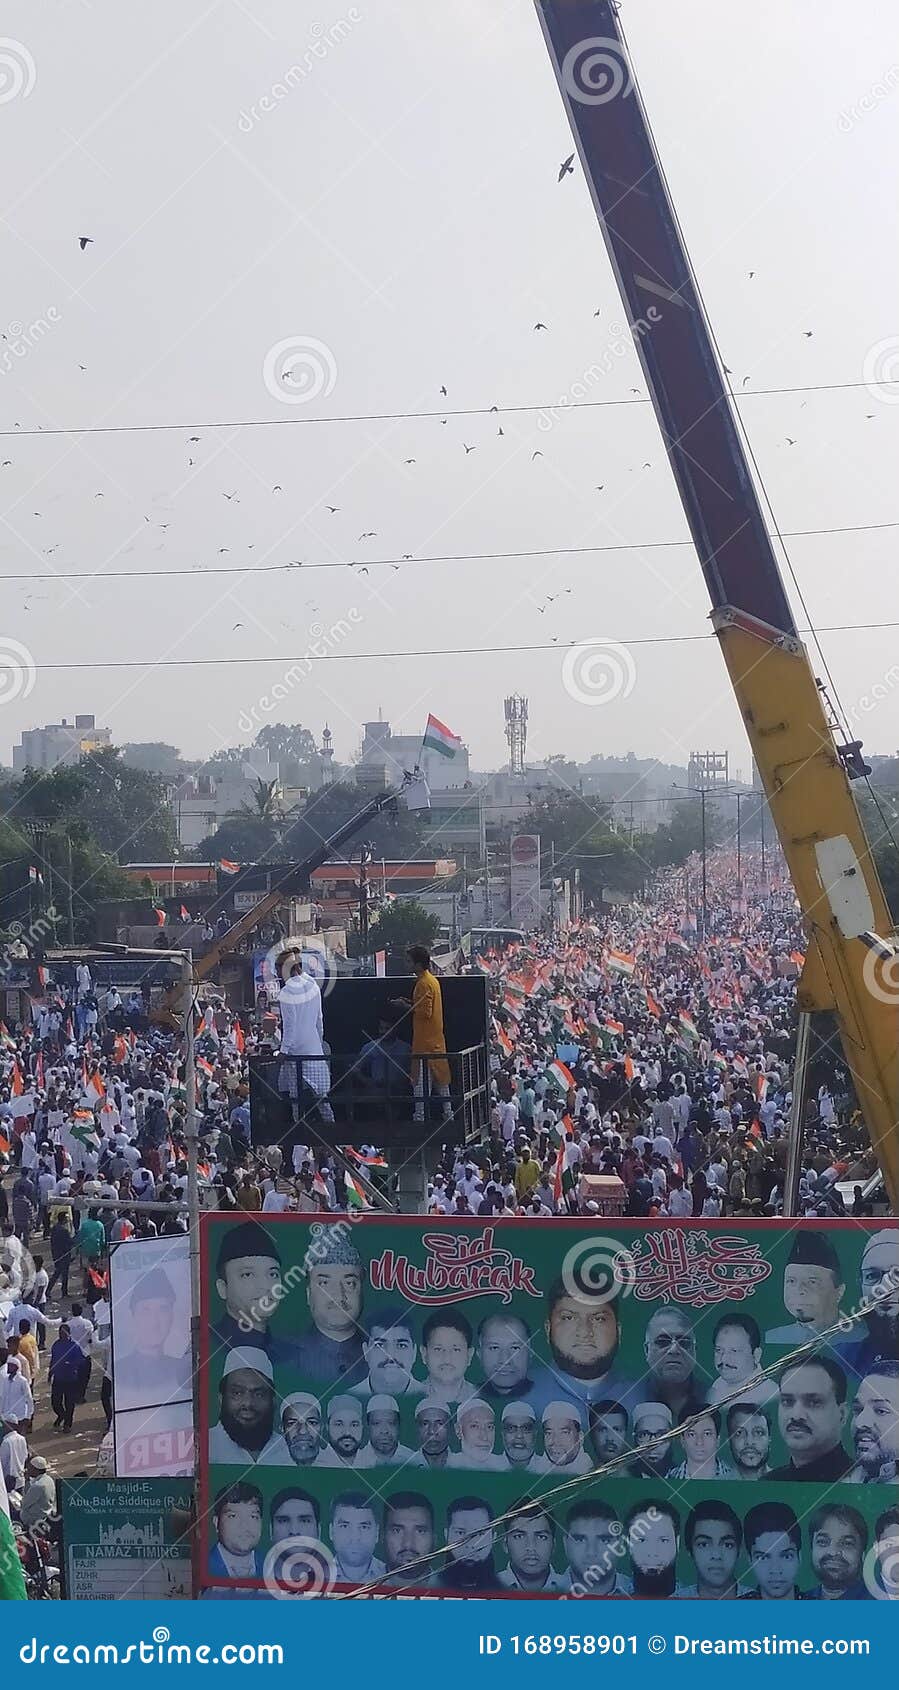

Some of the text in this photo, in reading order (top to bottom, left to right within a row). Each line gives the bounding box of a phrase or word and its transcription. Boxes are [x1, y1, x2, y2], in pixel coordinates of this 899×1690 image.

[422, 1227, 512, 1267] Eid
[370, 1250, 544, 1306] Mubarak
[69, 1496, 116, 1507] Abu-Bakr
[118, 1495, 161, 1508] Siddique
[86, 1546, 180, 1558] NAMAZ TIMING
[75, 1560, 97, 1568] FAJR
[75, 1571, 98, 1580] ZUHR
[76, 1582, 94, 1591] ASR
